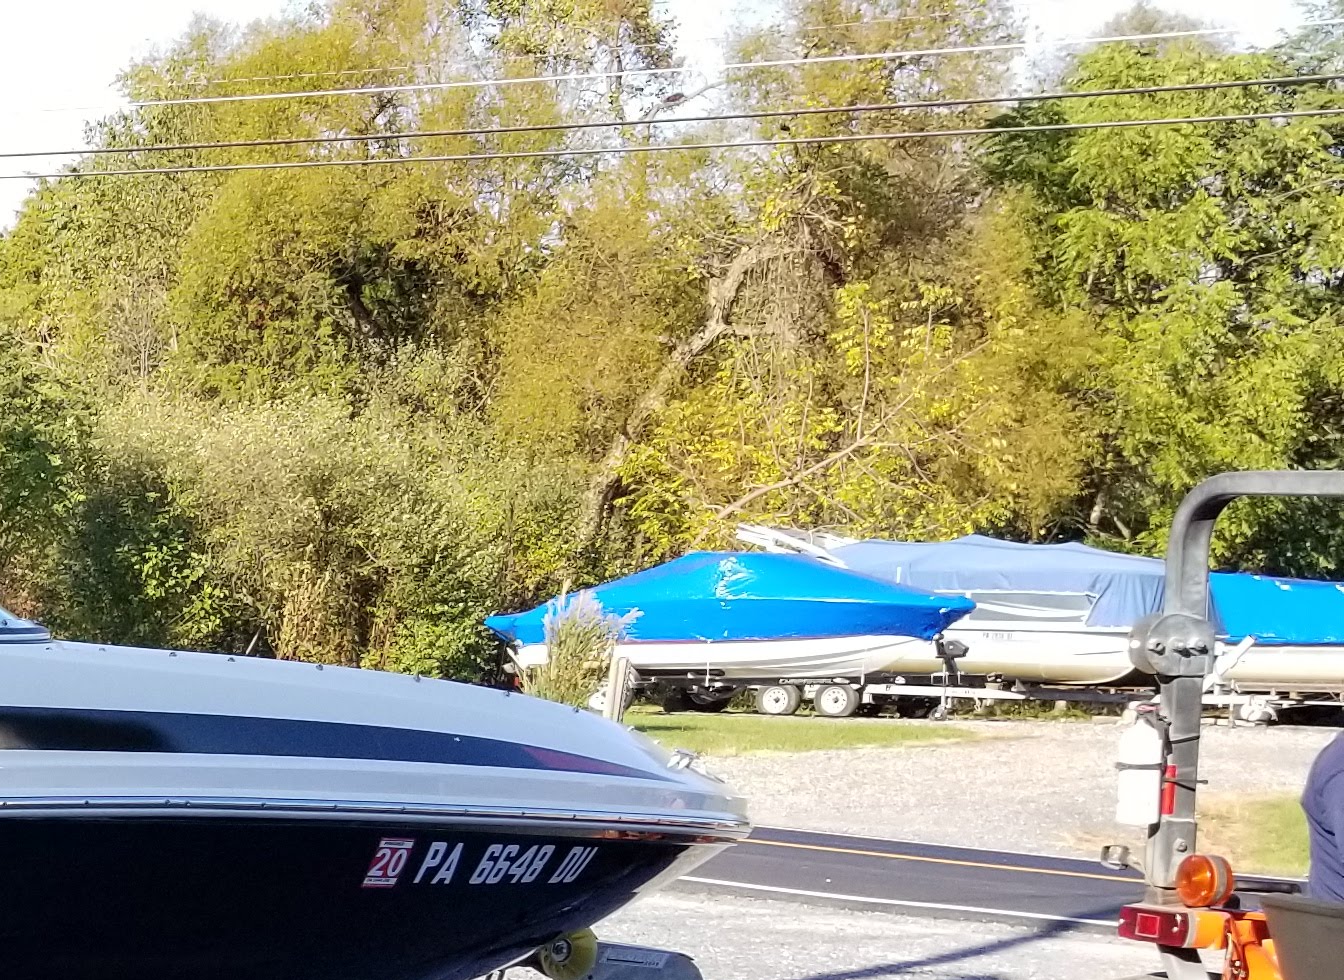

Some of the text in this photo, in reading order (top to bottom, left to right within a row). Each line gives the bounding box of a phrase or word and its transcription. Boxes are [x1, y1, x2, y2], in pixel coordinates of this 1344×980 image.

[367, 848, 408, 877] 20
[413, 841, 598, 884] PA 6648 DU
